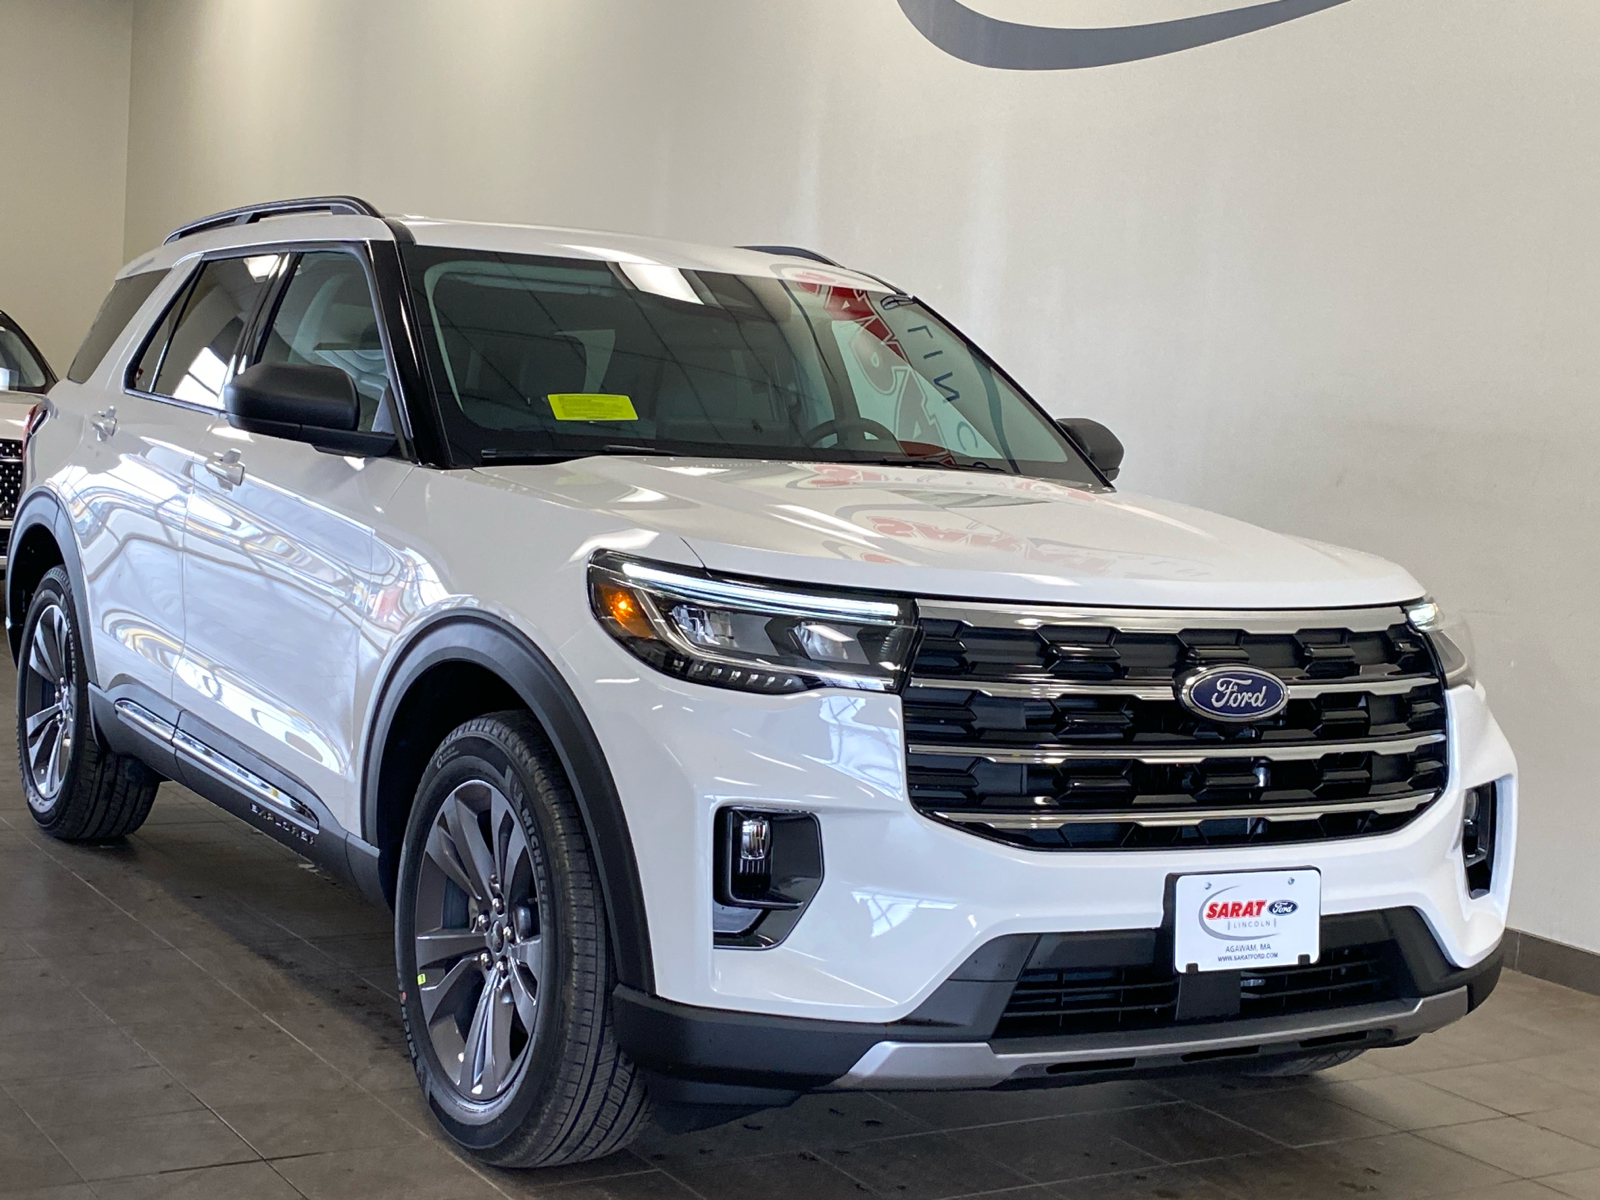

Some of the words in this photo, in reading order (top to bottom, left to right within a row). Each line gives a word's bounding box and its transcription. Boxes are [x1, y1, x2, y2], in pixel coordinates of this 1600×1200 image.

[1211, 677, 1267, 708] Ford
[1206, 900, 1268, 920] SARAT
[1271, 902, 1294, 914] Ford
[1233, 920, 1271, 929] LINCOLN
[1225, 944, 1258, 953] AGAWAM,
[1260, 943, 1272, 951] MA
